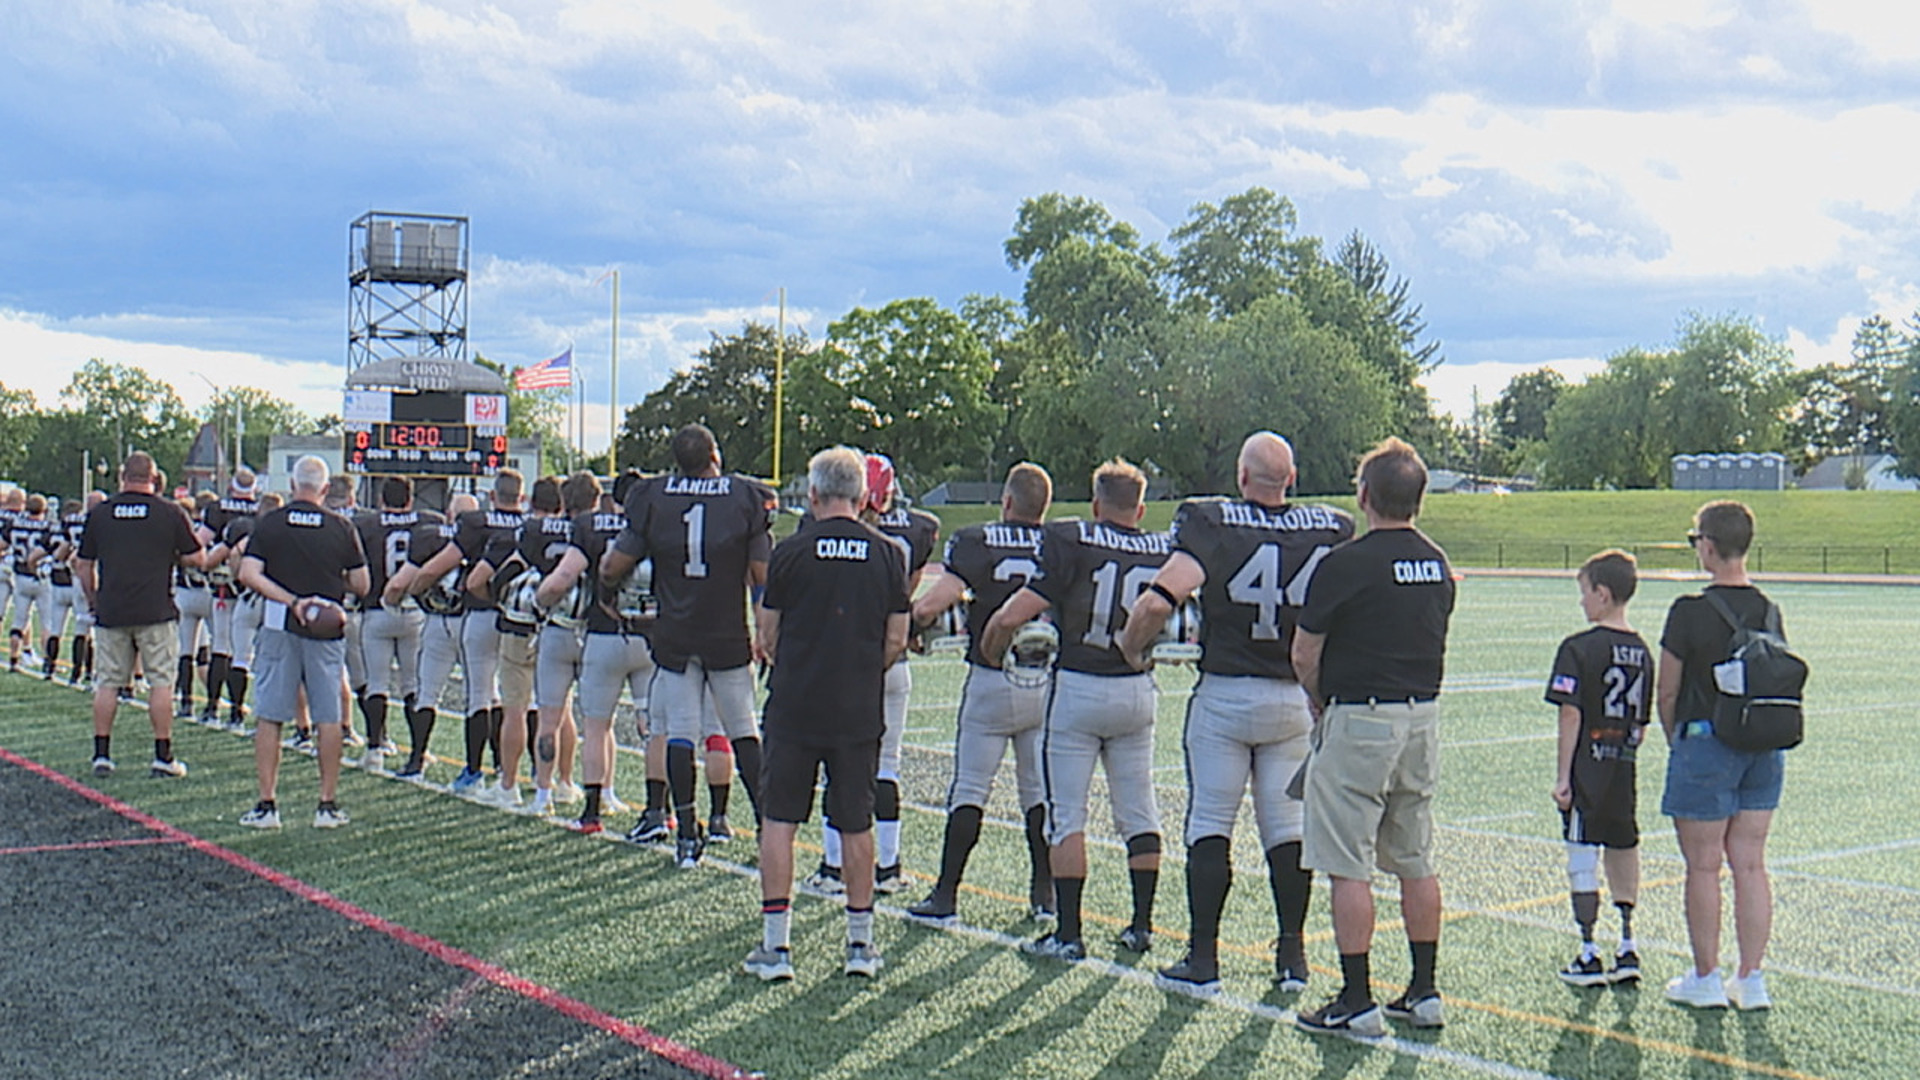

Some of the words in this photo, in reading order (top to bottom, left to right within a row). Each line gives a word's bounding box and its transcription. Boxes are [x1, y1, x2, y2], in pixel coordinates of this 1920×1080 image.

[356, 431, 368, 449] 0
[493, 436, 506, 453] 0
[664, 476, 731, 495] LANIER
[113, 504, 147, 519] COACH
[288, 511, 322, 527] COACH
[683, 503, 707, 577] 1
[816, 538, 868, 560] COACH
[1393, 559, 1443, 584] COACH
[1603, 666, 1645, 720] 24
